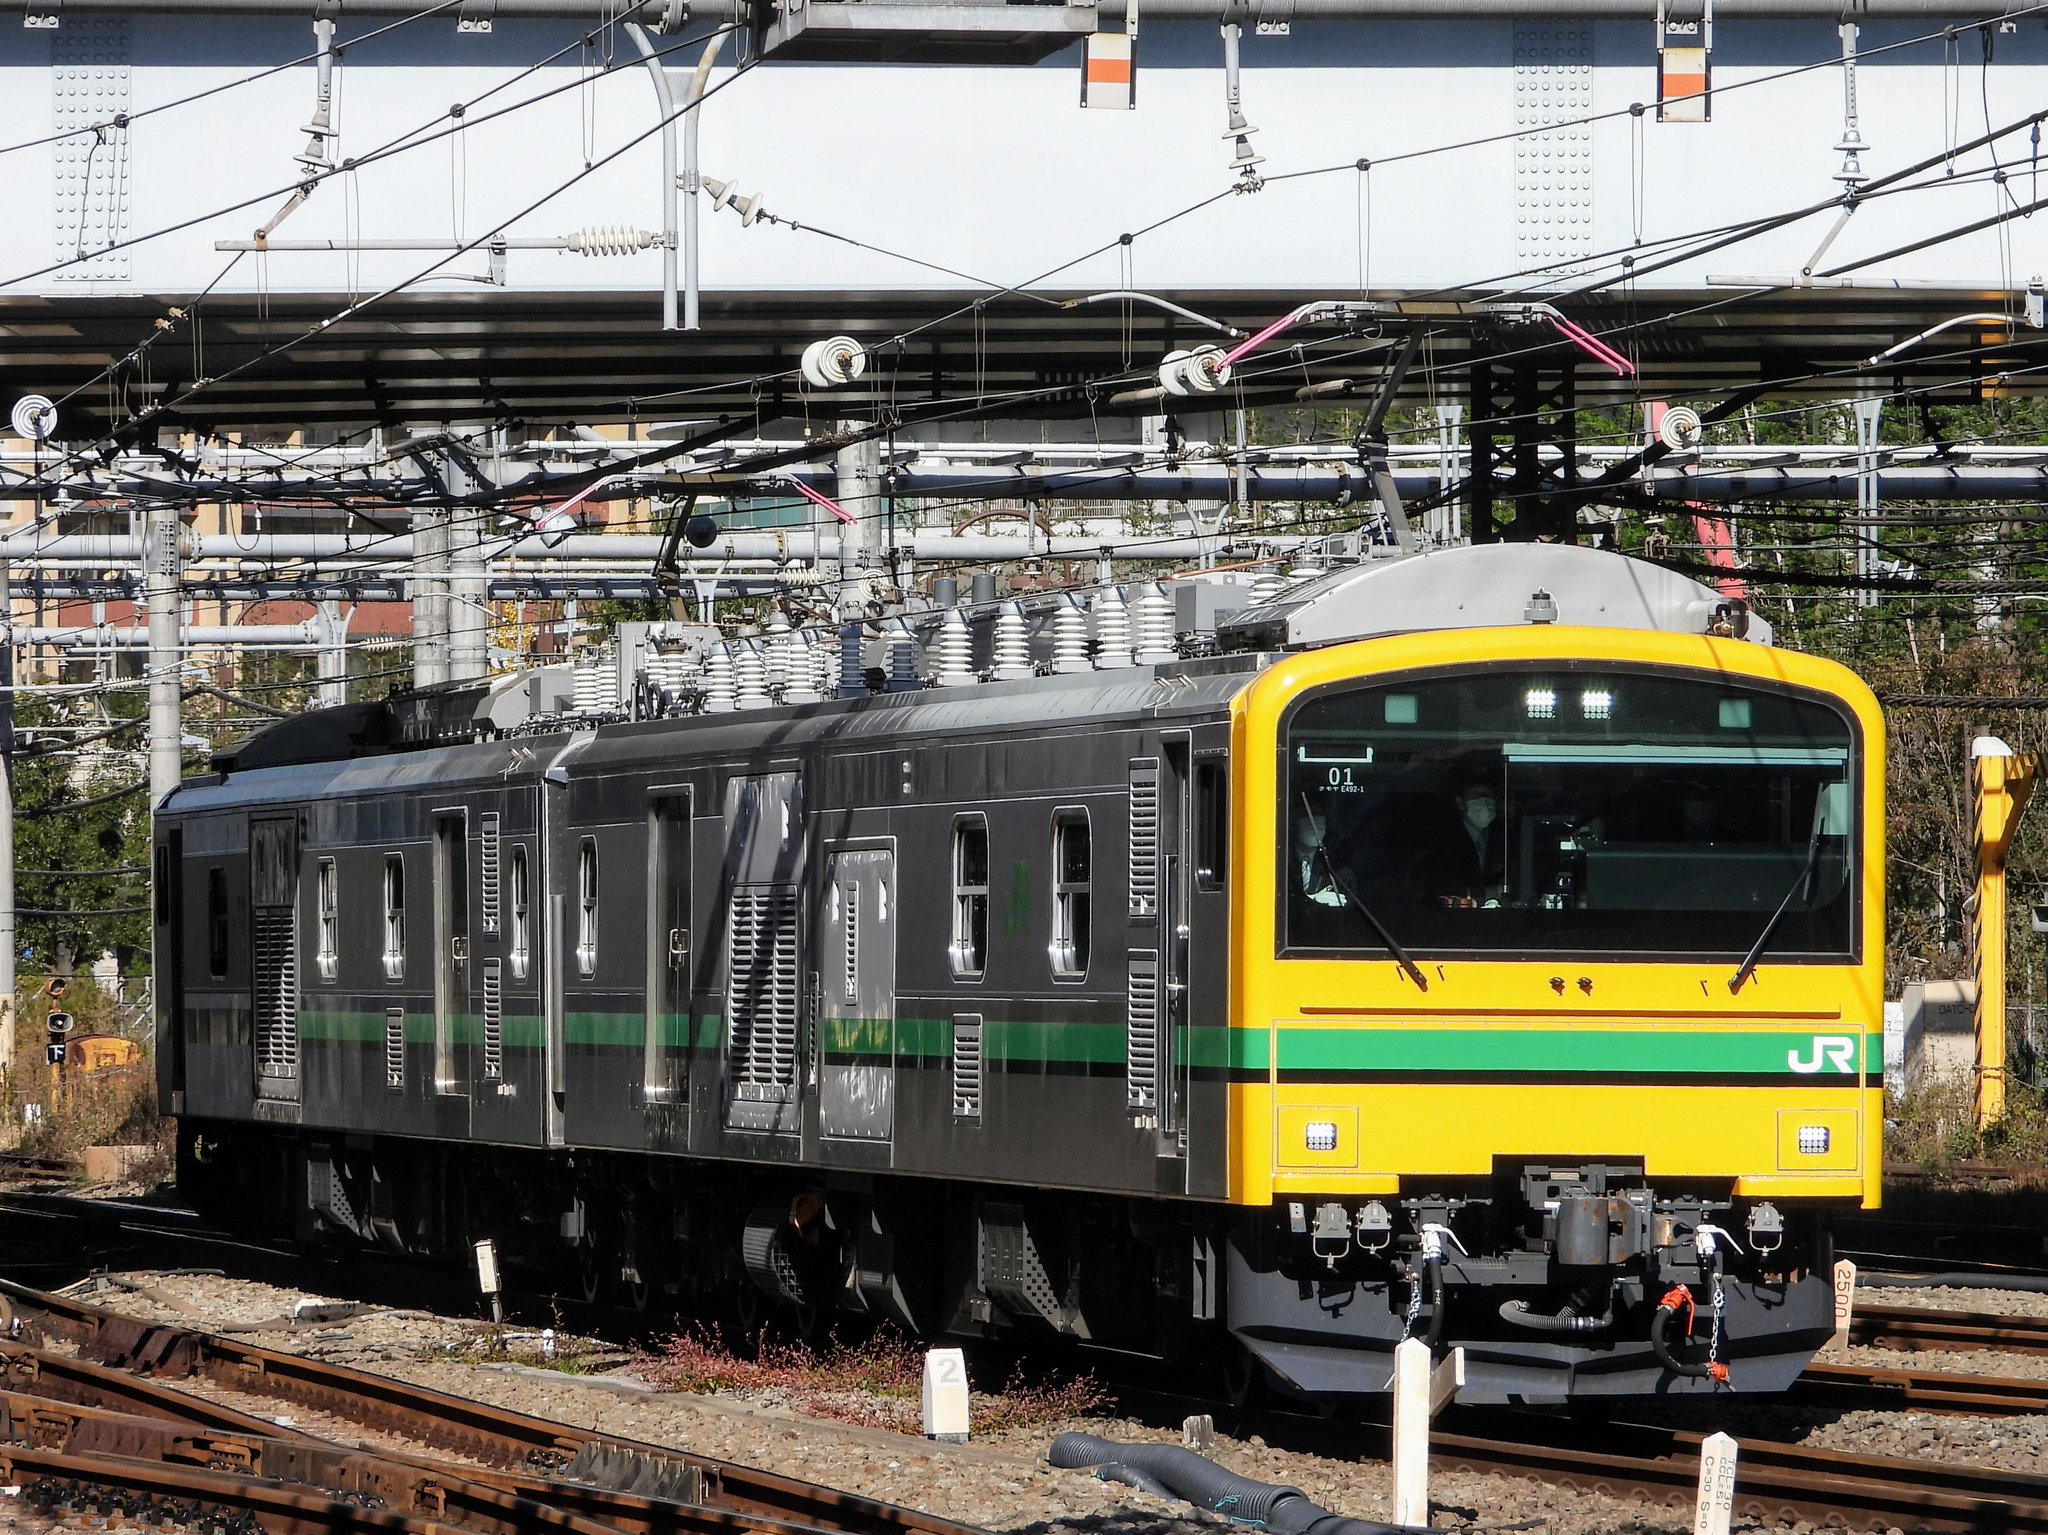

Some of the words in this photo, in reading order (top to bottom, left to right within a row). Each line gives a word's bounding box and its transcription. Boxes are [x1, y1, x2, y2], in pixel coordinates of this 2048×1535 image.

[1328, 767, 1354, 786] 01
[1341, 785, 1365, 793] E492-1
[48, 1044, 66, 1060] 下
[1787, 1036, 1854, 1074] JR
[1836, 1269, 1851, 1318] 2500
[938, 1358, 960, 1383] 2
[1703, 1456, 1715, 1492] C=30
[1723, 1458, 1735, 1511] TCL=30
